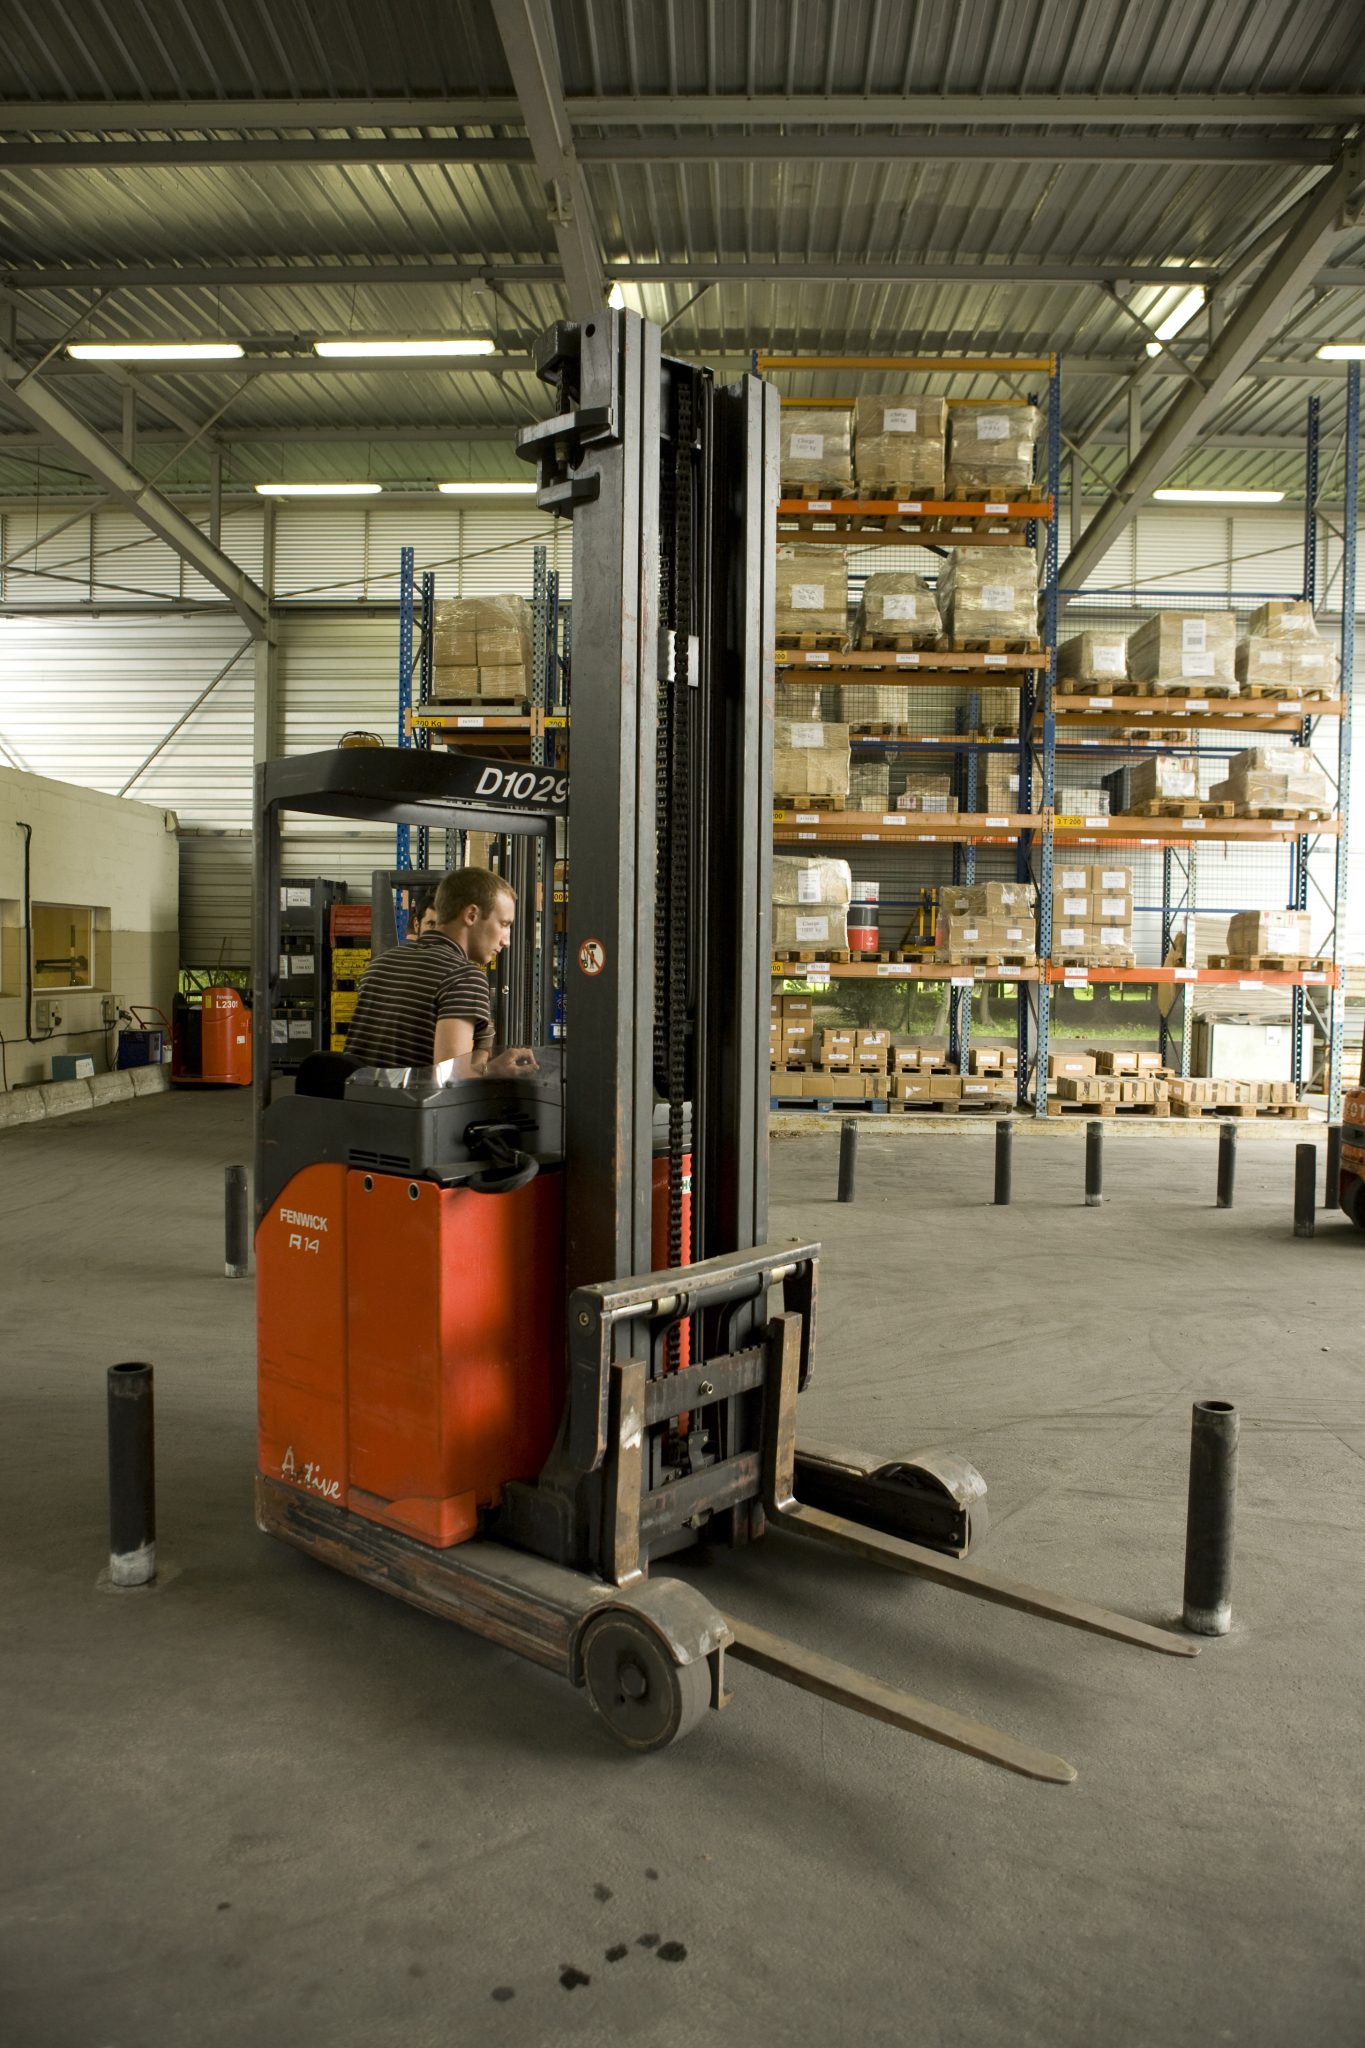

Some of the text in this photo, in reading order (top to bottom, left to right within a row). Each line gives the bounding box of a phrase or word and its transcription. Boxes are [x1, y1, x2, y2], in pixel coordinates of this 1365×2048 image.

[475, 767, 570, 803] D1029
[280, 1208, 328, 1232] FENWICK
[281, 1445, 341, 1500] Ative
